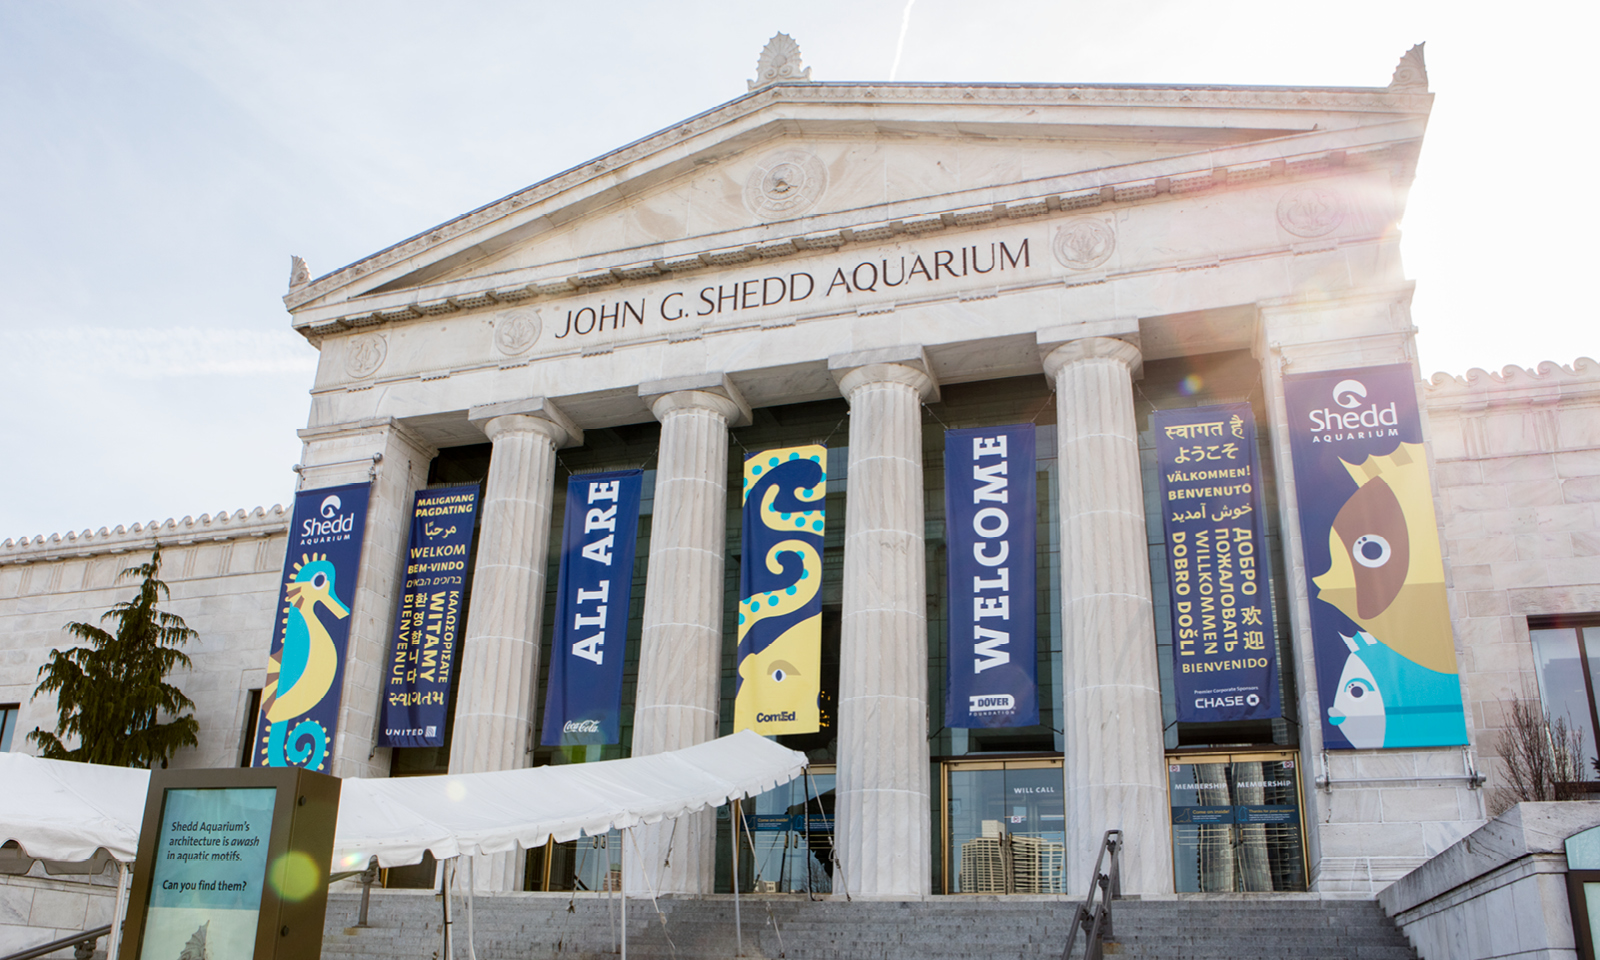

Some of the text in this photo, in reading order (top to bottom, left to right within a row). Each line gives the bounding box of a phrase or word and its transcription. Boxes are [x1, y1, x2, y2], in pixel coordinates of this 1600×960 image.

[555, 237, 1030, 340] JOHN G. SHEDD AQUARIUM
[1308, 401, 1398, 432] Shedd
[1164, 414, 1245, 440] स्वागत है
[1312, 428, 1399, 443] AQUARIUM
[1174, 442, 1239, 464] ようこそ
[1166, 465, 1251, 483] VÄLKOMMEN!
[417, 494, 474, 507] MALIGAYANG
[1168, 483, 1252, 501] BENVENUTO
[415, 504, 473, 518] PAGDATING
[1211, 502, 1252, 522] خوش
[300, 512, 354, 538] Shedd
[300, 534, 350, 546] AQUARIUM
[410, 544, 466, 559] WELKOM
[973, 434, 1010, 674] WELCOME
[407, 561, 464, 574] BEM-VINDO
[1232, 527, 1258, 596] ДОБРО
[572, 480, 620, 665] ALL ARE
[1172, 531, 1198, 656] DOBRO DOŠLI
[1195, 530, 1218, 655] WILLKOMMEN
[1214, 528, 1238, 652] ПОЖАЛОВАТЬ
[1240, 606, 1265, 650] 欢迎
[391, 594, 414, 685] BIENVENUE
[420, 591, 446, 683] WITAMY
[1182, 657, 1268, 674] BIENVENIDO
[978, 698, 1009, 707] DOVER
[1195, 696, 1244, 708] CHASE
[756, 711, 796, 723] ComEd
[386, 728, 424, 736] UNITED
[1174, 782, 1228, 790] MEMBERSHIP
[1237, 780, 1292, 788] MEMBERSHIP
[172, 821, 198, 832] Shedd
[169, 836, 260, 846] architecture is awash
[166, 850, 242, 864] in aquatic motifs.
[162, 880, 247, 893] Can you find them?
